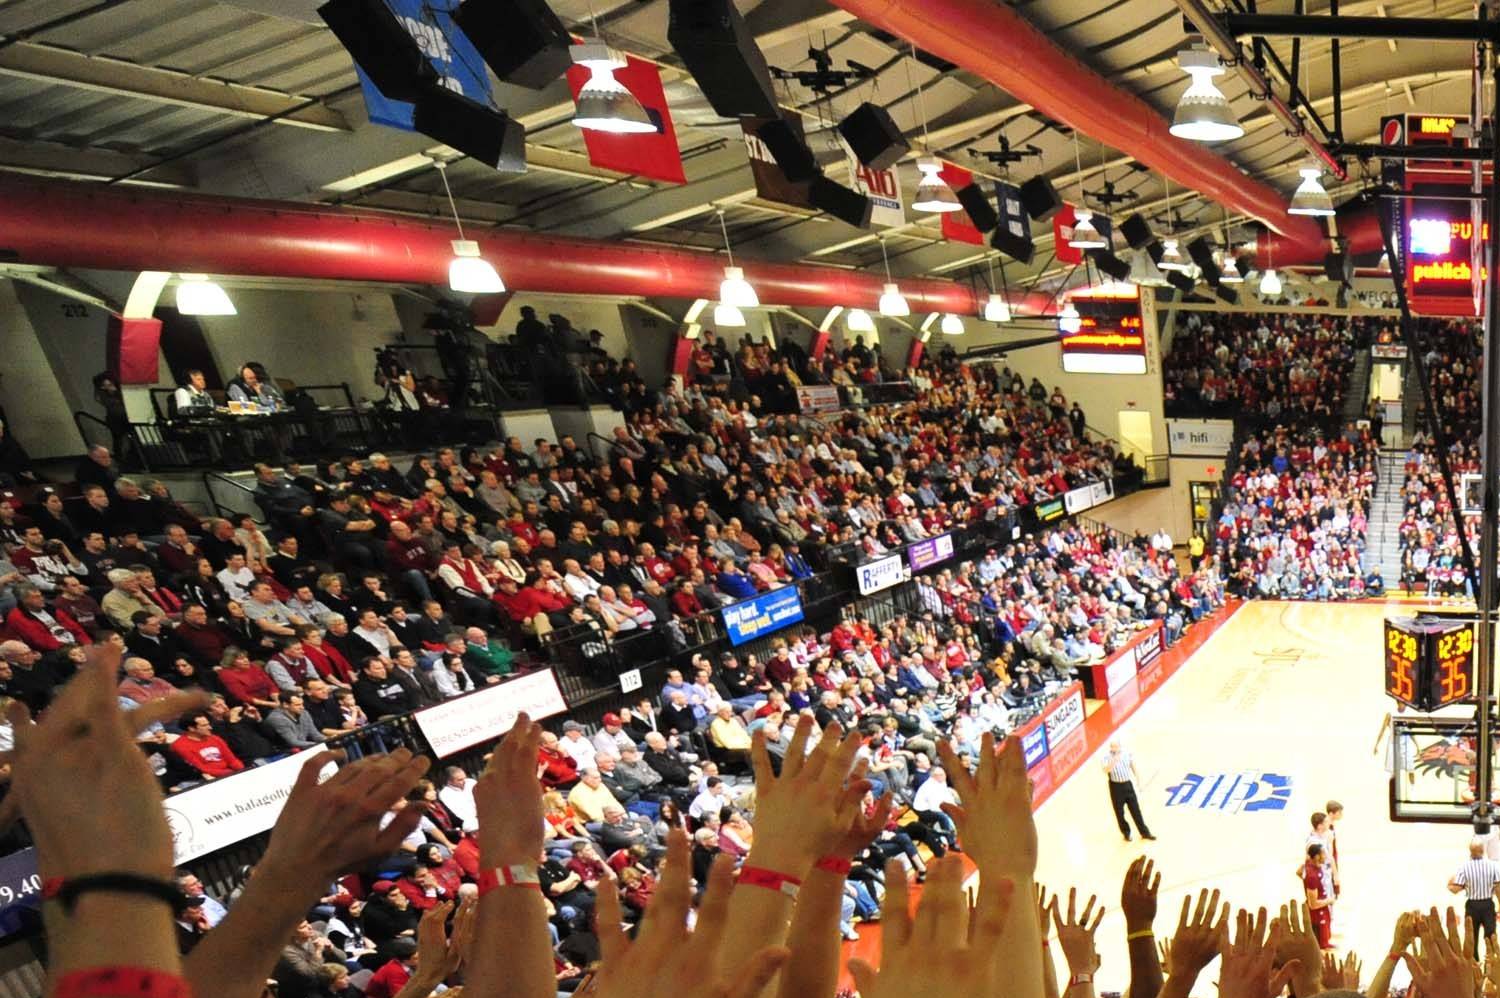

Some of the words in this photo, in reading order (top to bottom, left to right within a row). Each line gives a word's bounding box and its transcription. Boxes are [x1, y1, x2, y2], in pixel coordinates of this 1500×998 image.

[1389, 630, 1417, 661] 12:30
[1439, 629, 1472, 659] 12:30
[624, 674, 639, 687] 112
[1391, 654, 1412, 701] 35
[1441, 656, 1467, 702] 35
